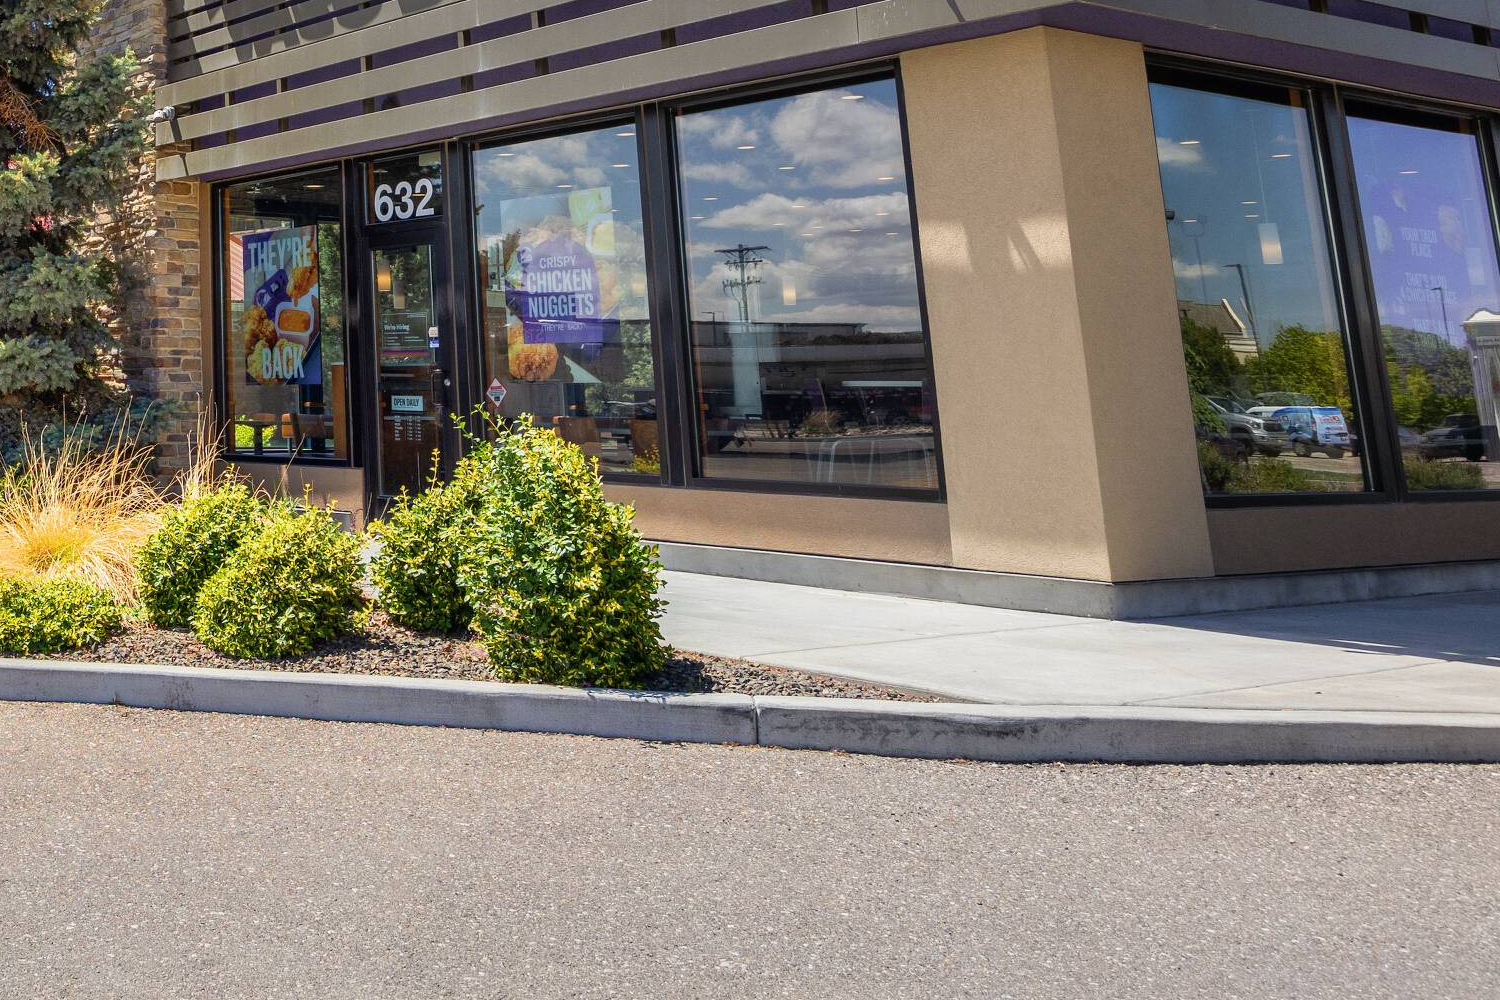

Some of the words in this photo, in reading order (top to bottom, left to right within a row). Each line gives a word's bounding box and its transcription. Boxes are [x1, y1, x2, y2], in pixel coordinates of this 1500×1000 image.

[374, 178, 435, 222] 632
[247, 235, 312, 270] THEY'RE
[539, 255, 577, 269] CRISPY
[526, 268, 592, 294] CHICKEN
[528, 293, 595, 318] NUGGETS
[261, 345, 305, 380] BACK
[393, 398, 406, 406] OPEN
